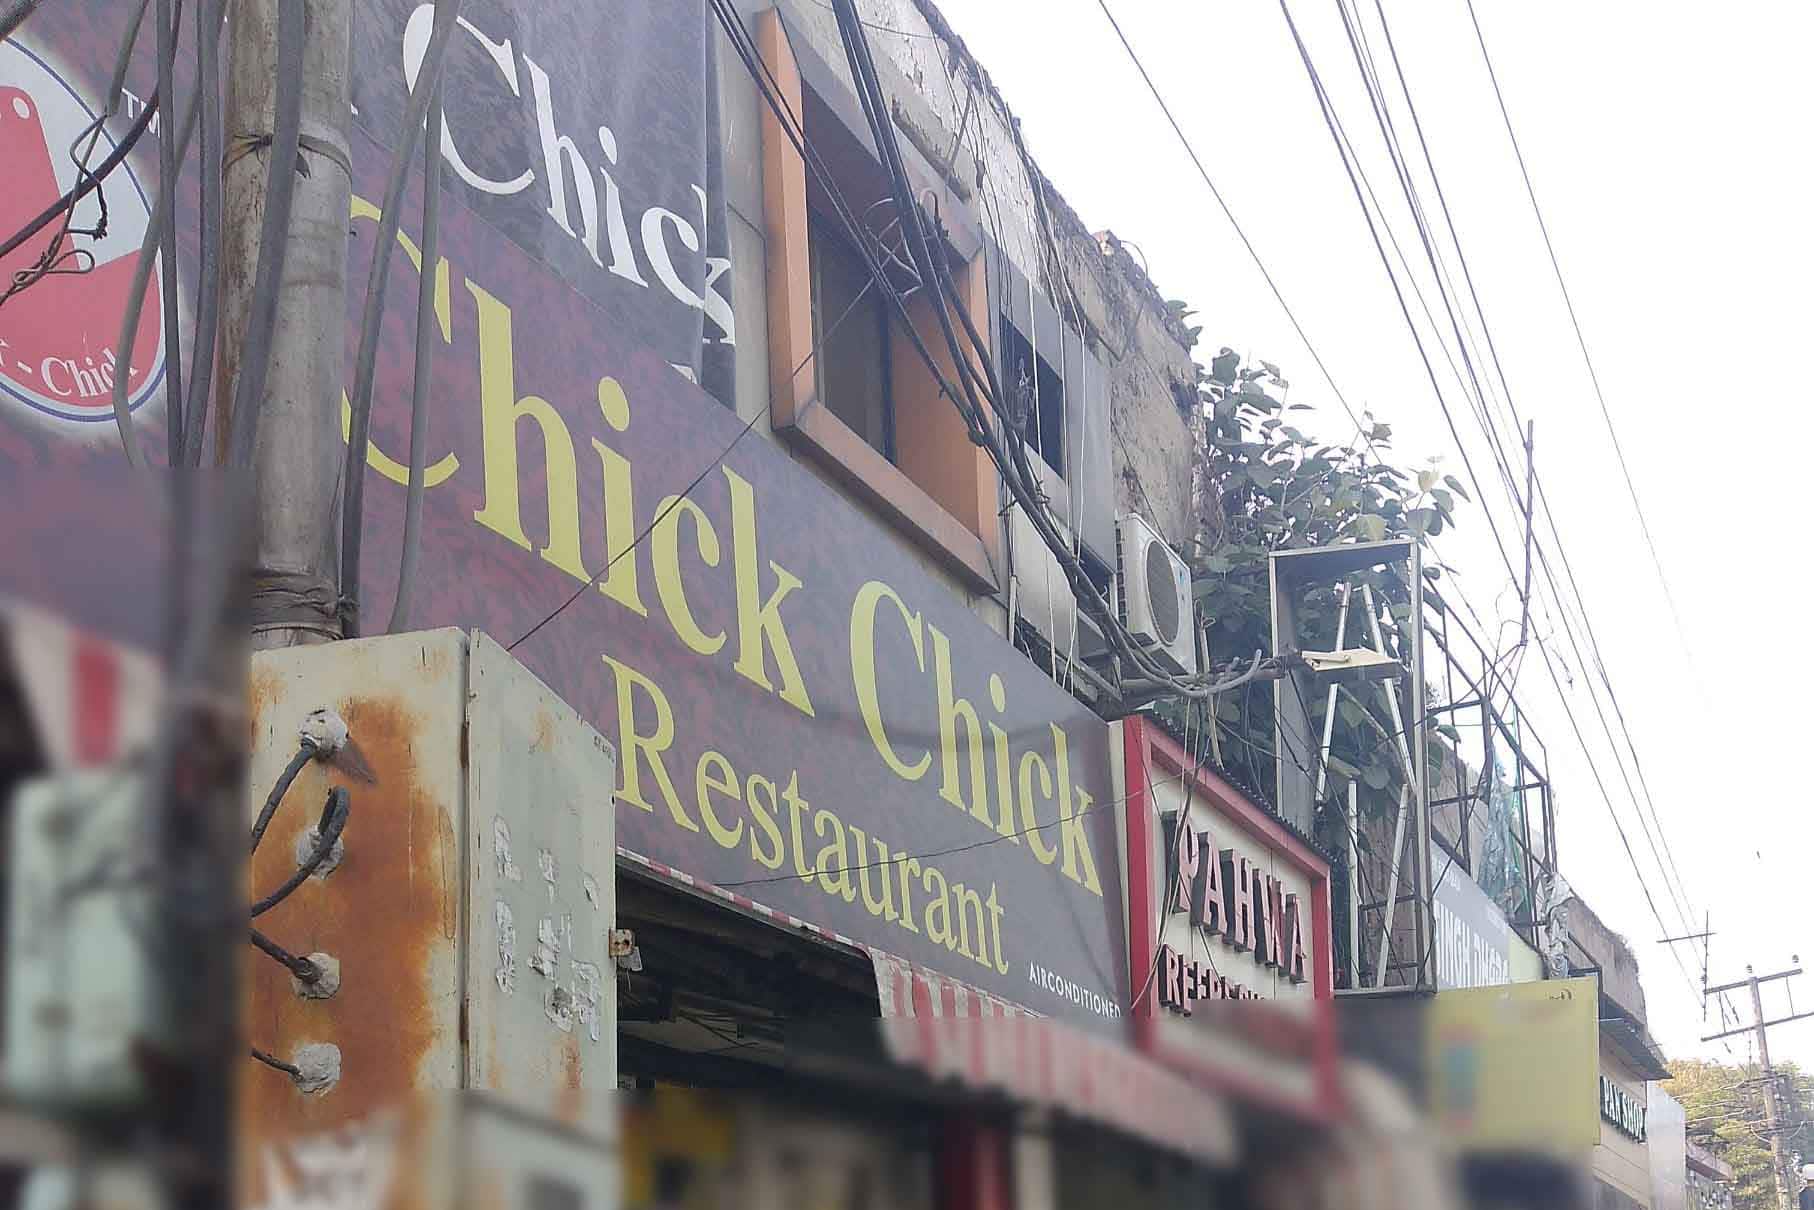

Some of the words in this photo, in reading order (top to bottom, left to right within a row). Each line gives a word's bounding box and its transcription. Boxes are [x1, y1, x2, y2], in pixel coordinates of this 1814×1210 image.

[602, 654, 1009, 976] Restaurant
[849, 580, 1104, 897] Chick
[1161, 809, 1309, 985] PAHWA
